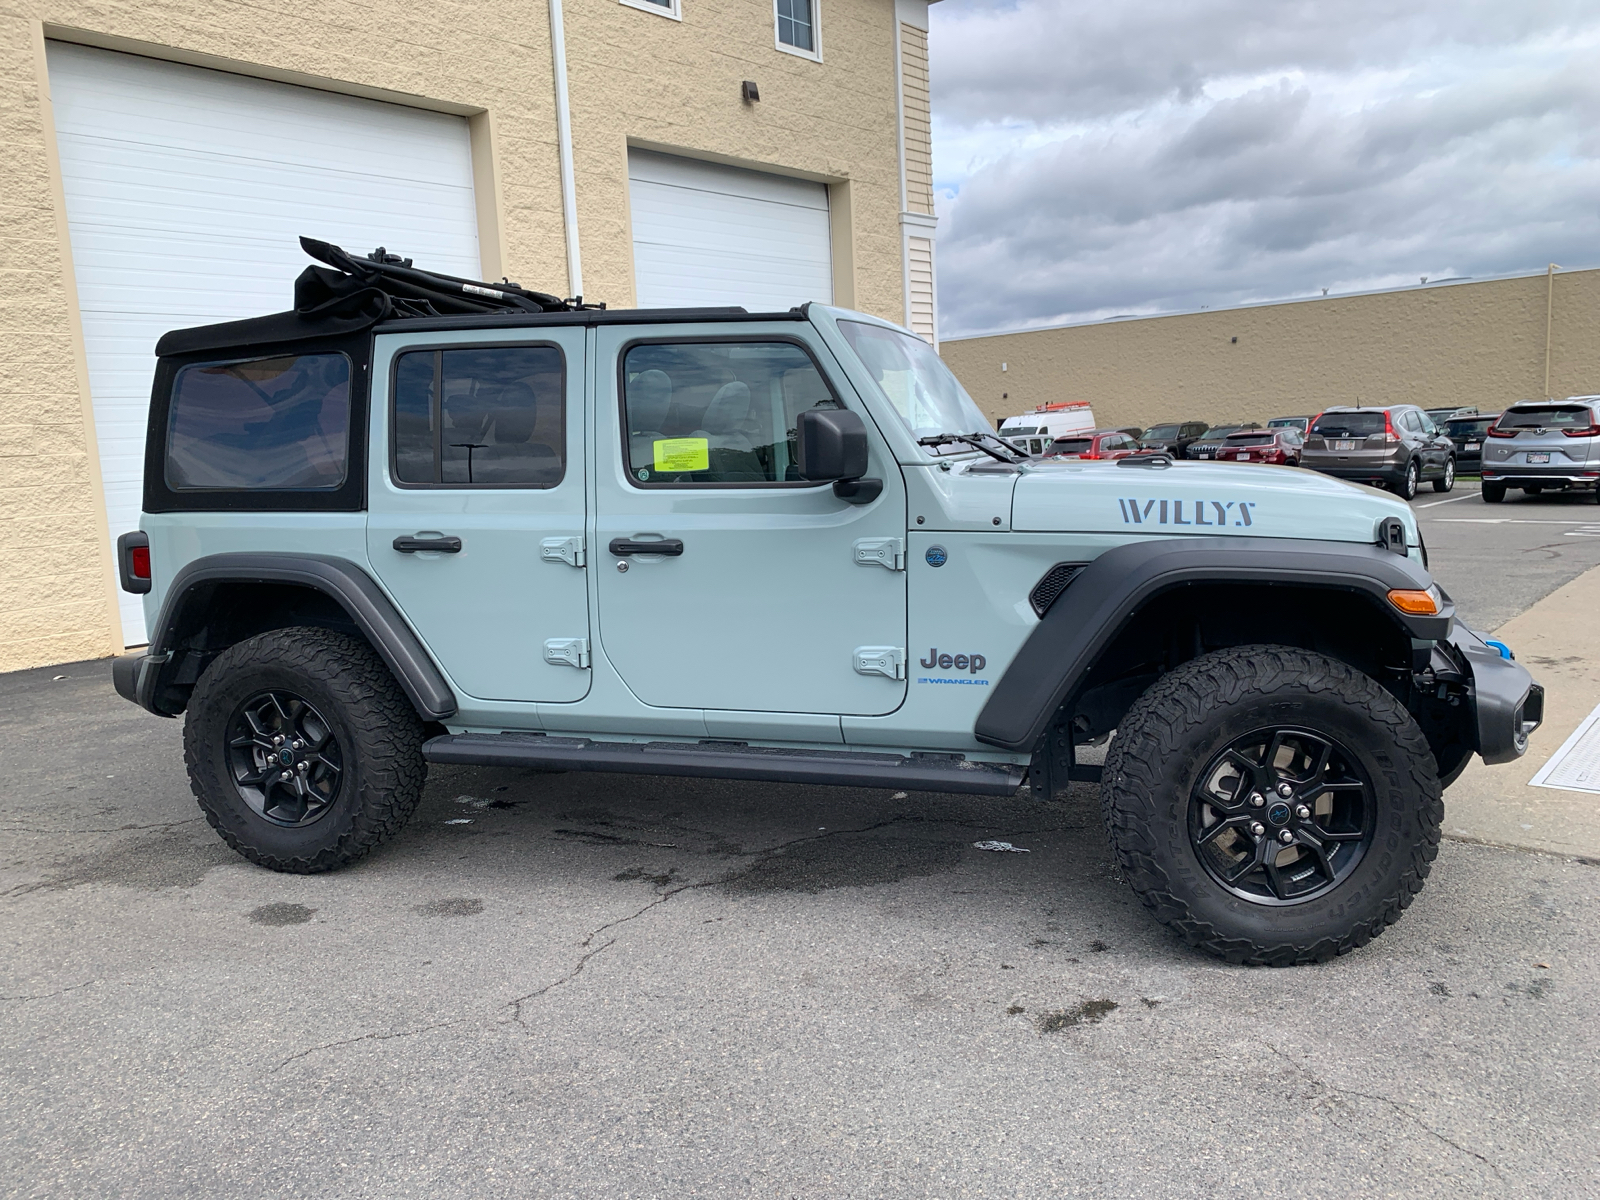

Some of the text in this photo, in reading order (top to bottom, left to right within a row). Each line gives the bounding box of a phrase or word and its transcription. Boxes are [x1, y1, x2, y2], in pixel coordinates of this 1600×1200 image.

[1118, 498, 1256, 527] WILLYS
[920, 647, 987, 674] Jeep
[928, 678, 989, 686] WRANGLER
[1328, 750, 1405, 919] BFGoodrich
